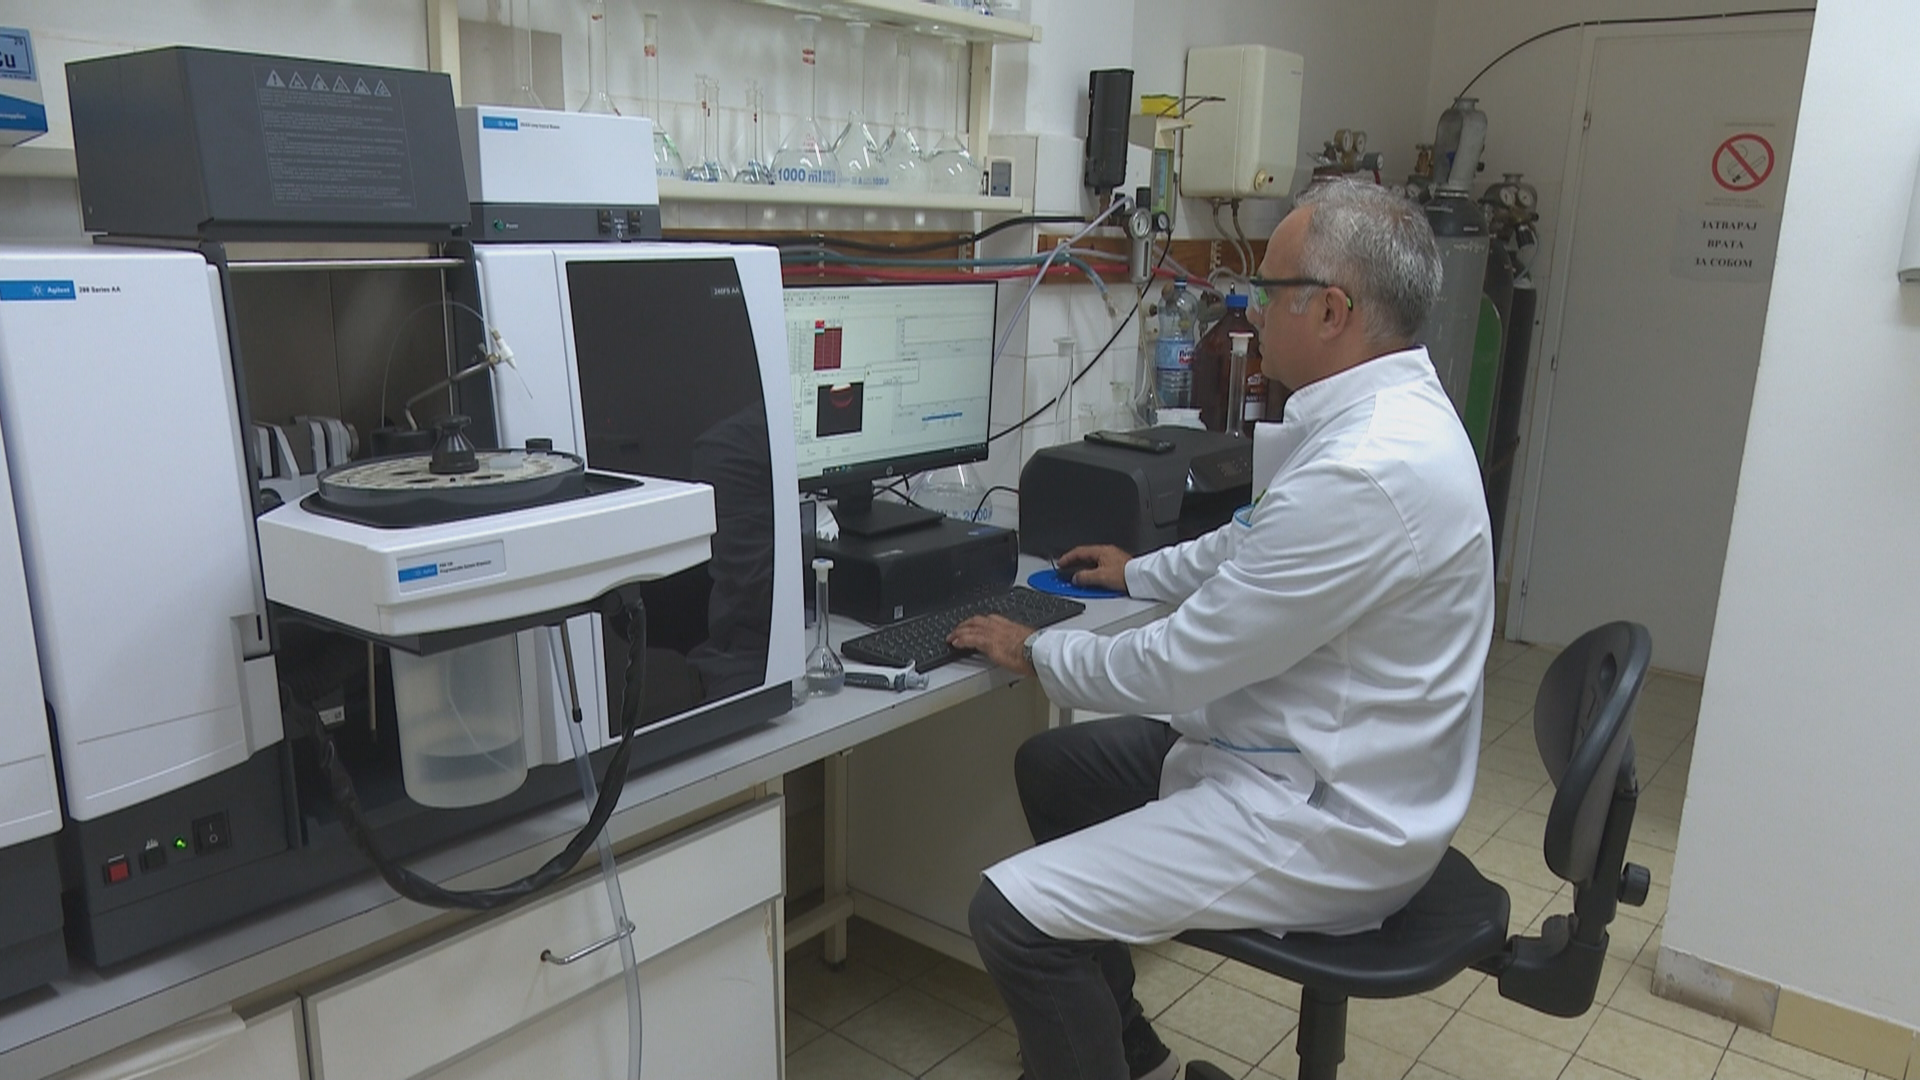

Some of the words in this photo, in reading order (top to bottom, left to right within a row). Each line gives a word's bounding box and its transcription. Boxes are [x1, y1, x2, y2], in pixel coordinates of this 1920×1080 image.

[778, 168, 806, 182] 1000
[808, 169, 822, 184] ml
[1702, 220, 1757, 230] ЗАТВАРАЈ
[1707, 239, 1744, 249] ВРАТА
[1696, 257, 1706, 266] ЗА
[1710, 258, 1752, 268] СОБОМ
[47, 286, 70, 295] Agilent
